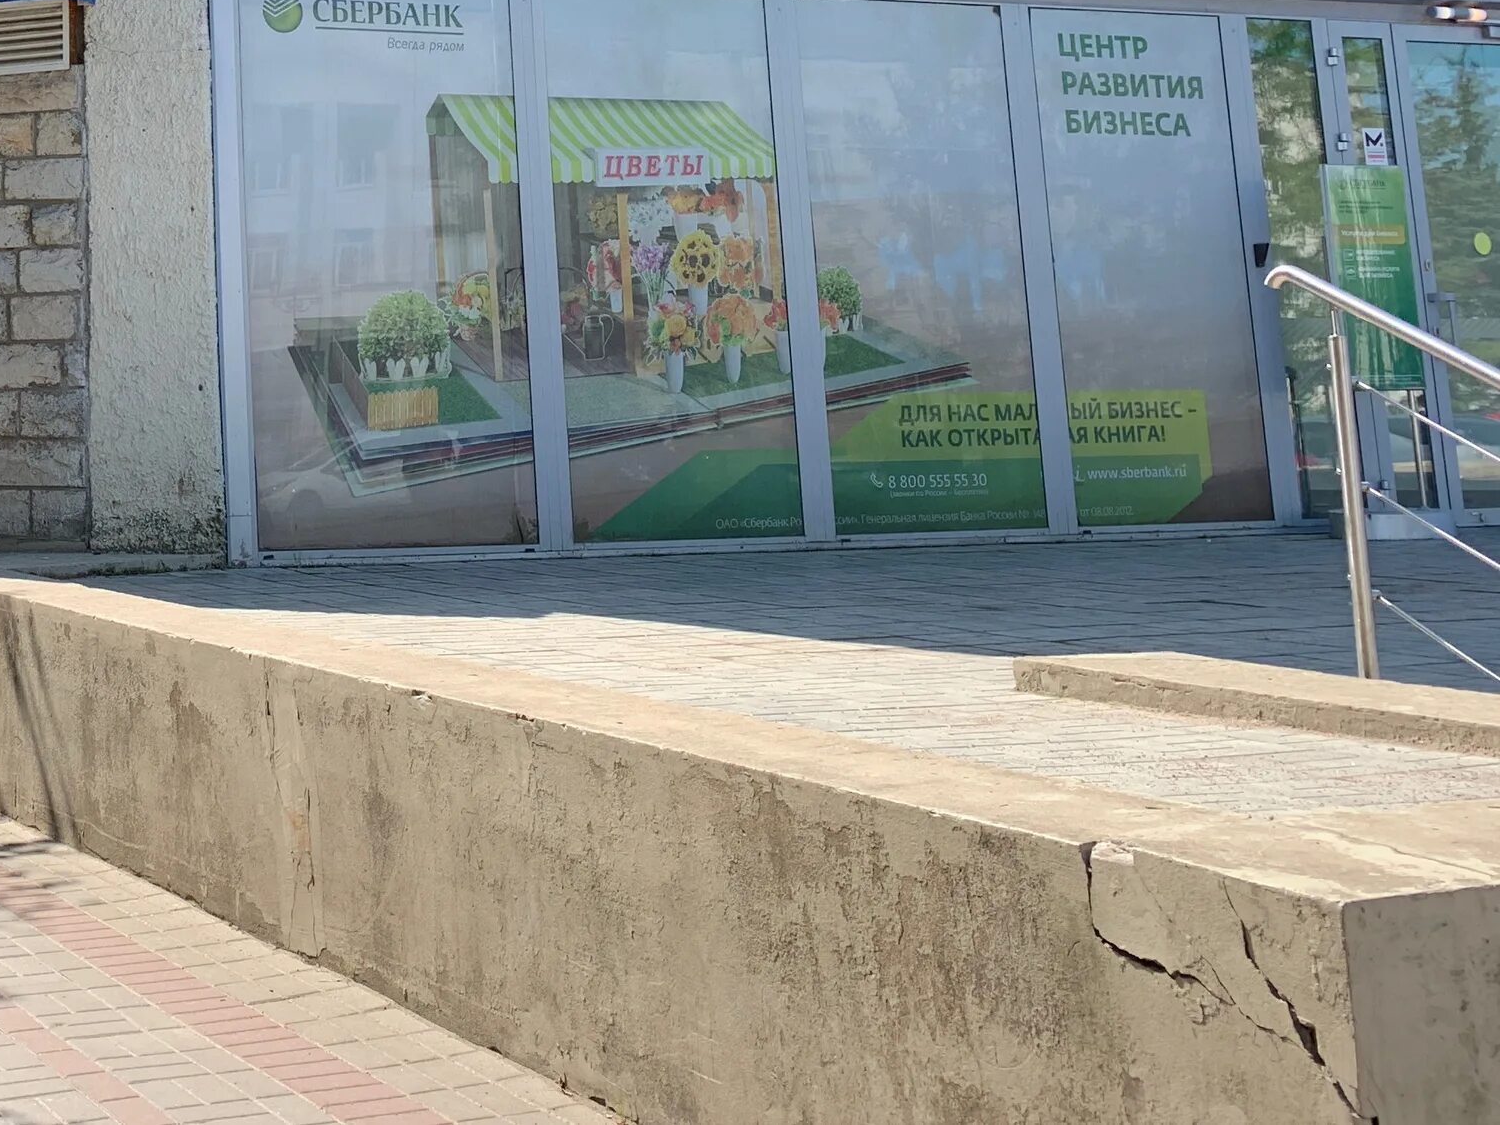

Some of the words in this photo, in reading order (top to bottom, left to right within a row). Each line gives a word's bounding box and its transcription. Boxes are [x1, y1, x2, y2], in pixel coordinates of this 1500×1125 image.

[387, 37, 425, 51] Всегда
[428, 40, 465, 54] рядом
[1057, 32, 1148, 62] ЦЕНТР
[1061, 70, 1204, 100] РАЗВИТИЯ
[1065, 109, 1191, 137] БИЗНЕСА
[604, 154, 704, 180] ЦВЕТЫ
[898, 404, 942, 426] ДЛЯ
[947, 403, 990, 422] НАС
[1107, 401, 1183, 420] БИЗНЕС
[901, 429, 943, 448] КАК
[1093, 424, 1166, 444] КНИГА!
[888, 475, 897, 489] 8
[899, 474, 926, 488] 800
[929, 474, 951, 488] 555
[954, 473, 969, 487] 55
[971, 473, 988, 487] 30
[1087, 463, 1187, 480] www.sberbank.ru
[715, 518, 738, 530] ОАО
